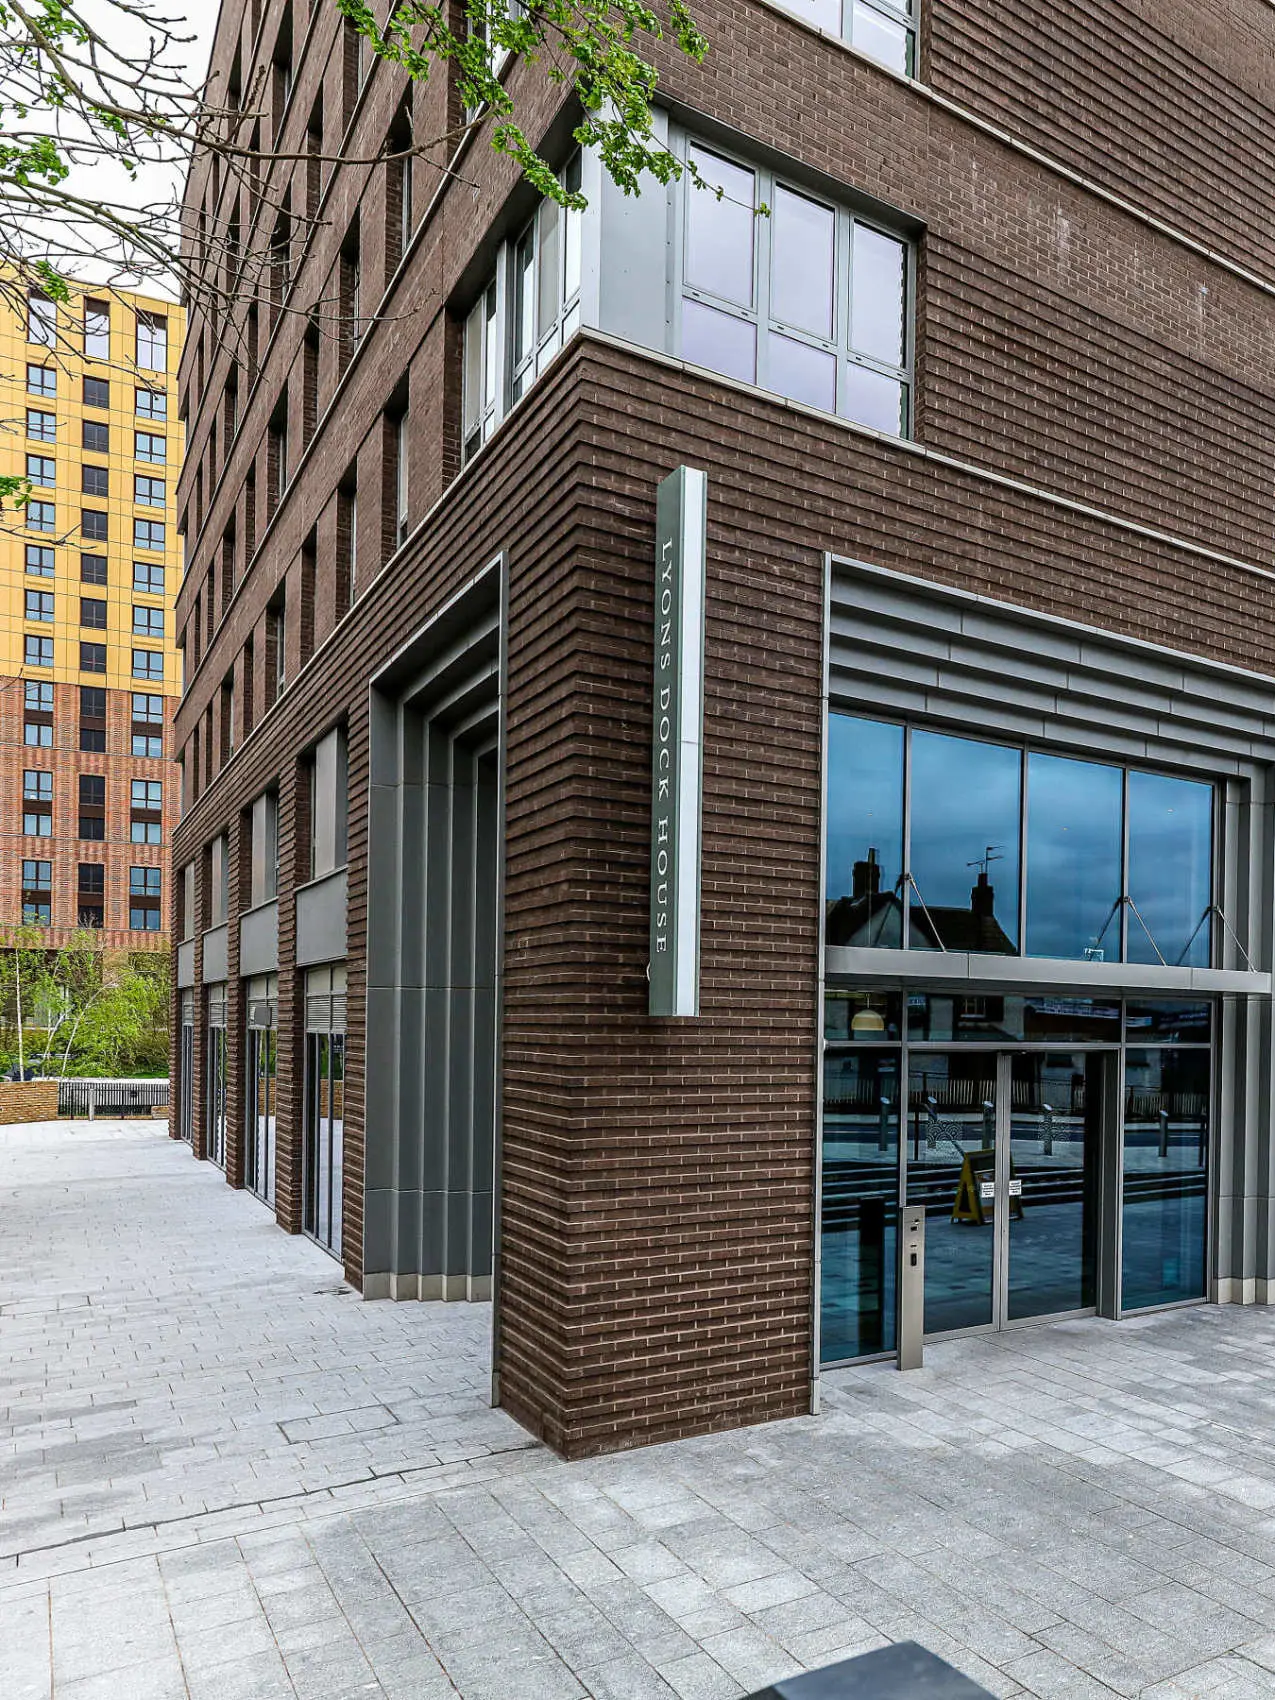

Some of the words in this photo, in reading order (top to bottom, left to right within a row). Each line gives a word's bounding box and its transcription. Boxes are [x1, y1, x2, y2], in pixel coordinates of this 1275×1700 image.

[660, 537, 673, 671] LYONS
[658, 686, 671, 802] DOCK
[656, 817, 669, 953] HOUSE
